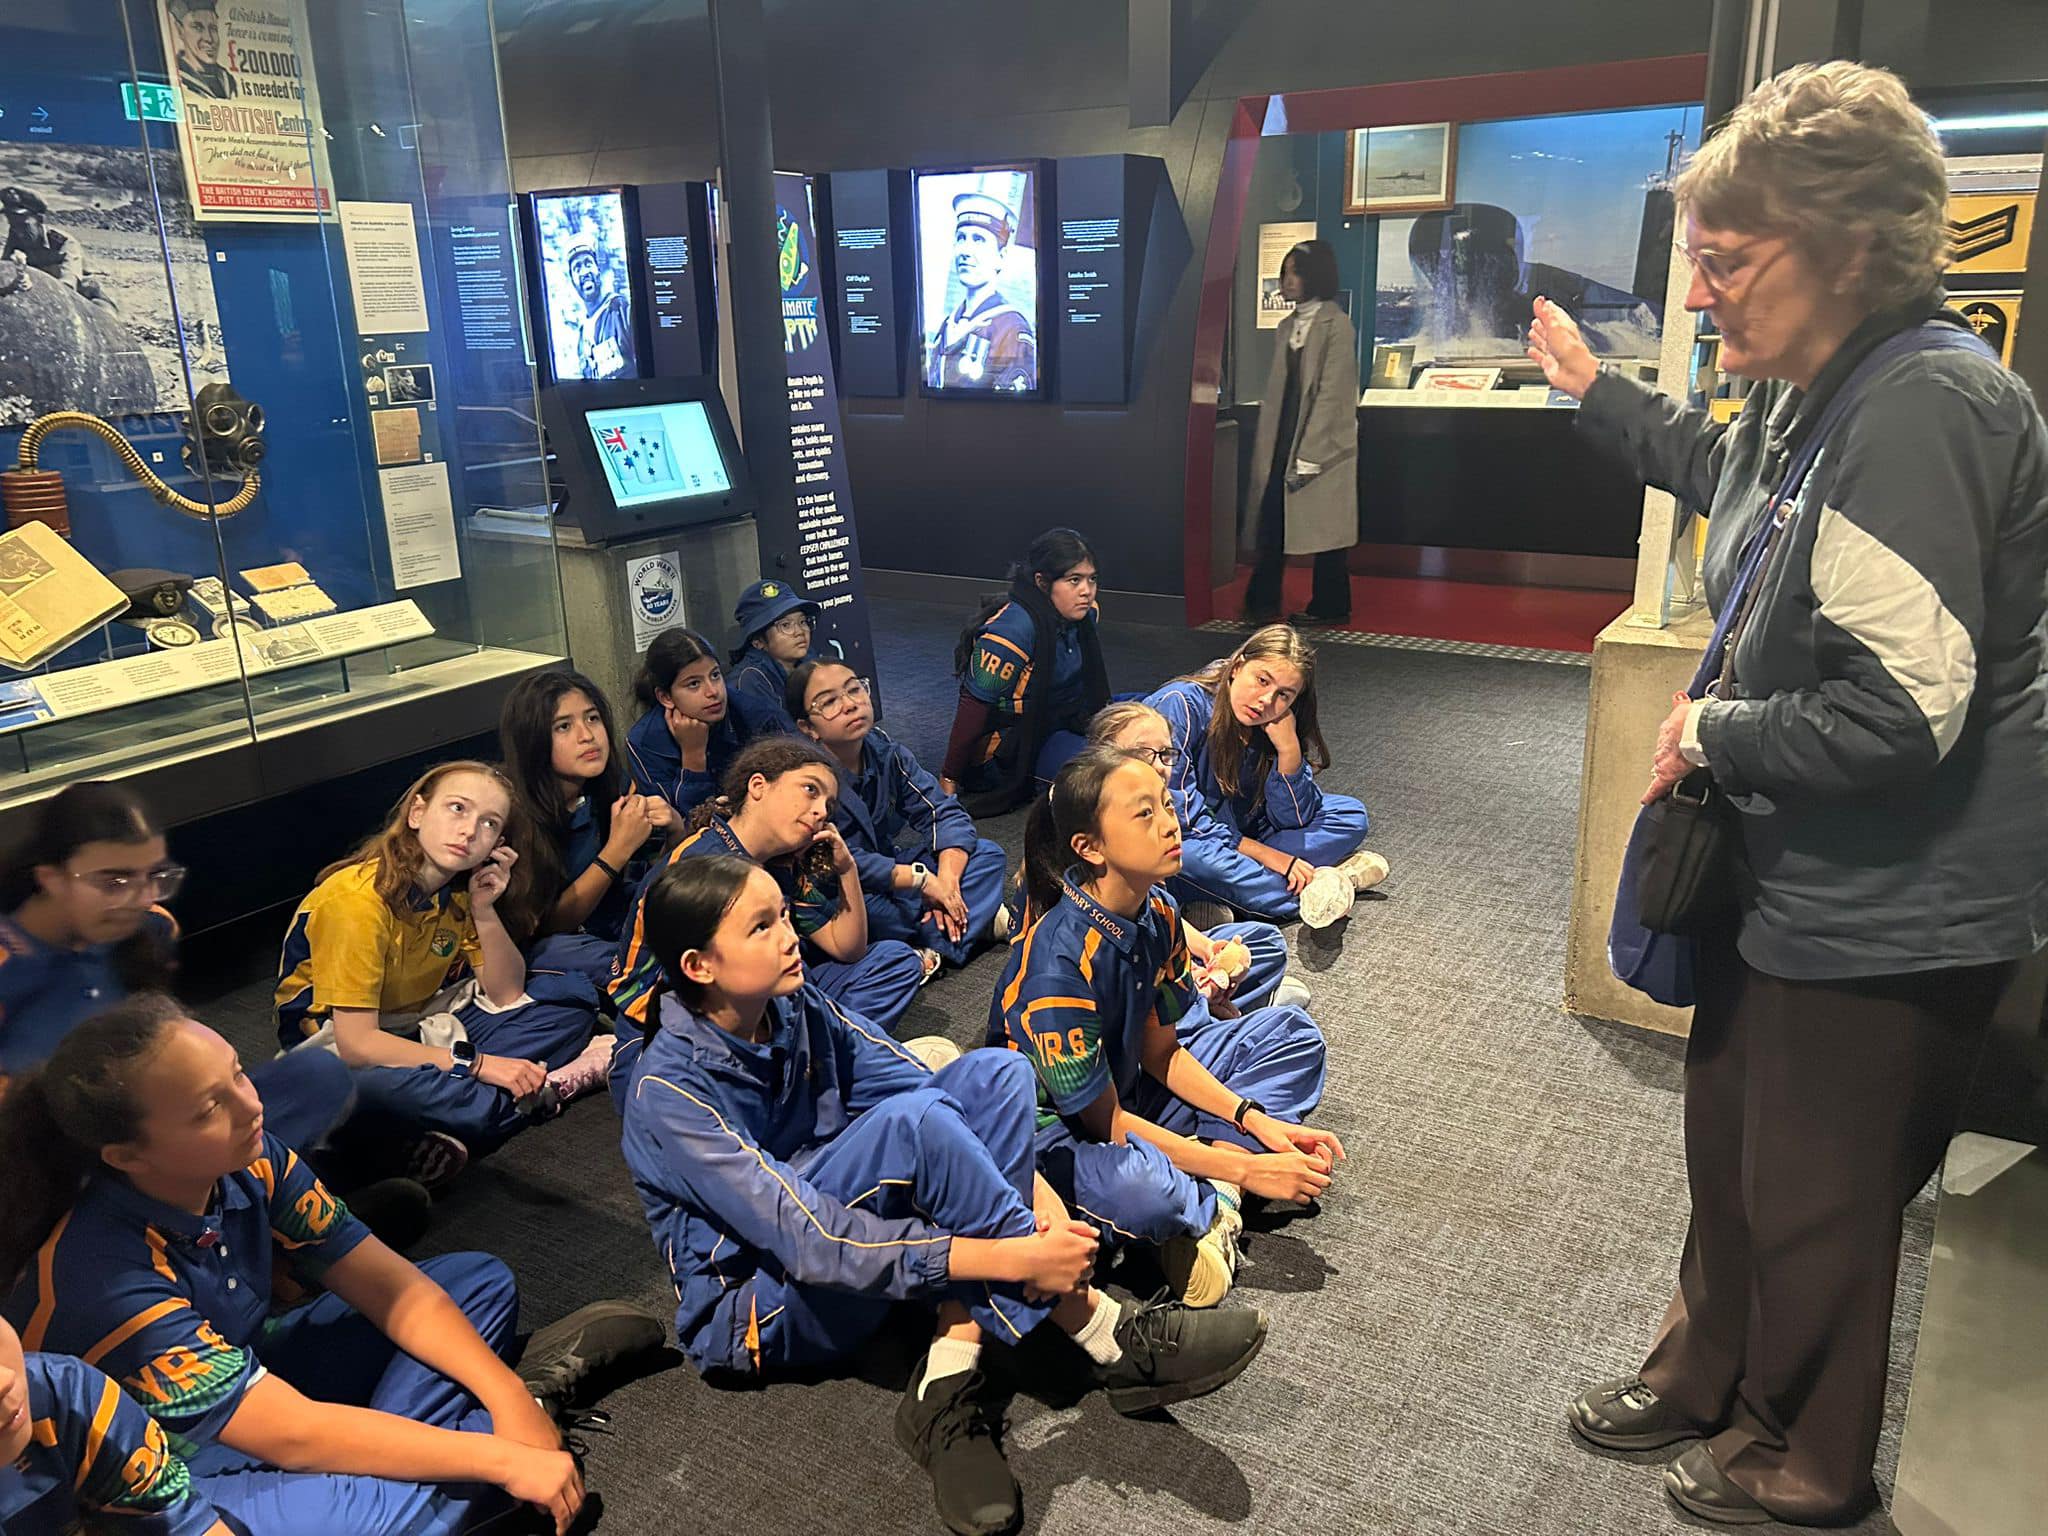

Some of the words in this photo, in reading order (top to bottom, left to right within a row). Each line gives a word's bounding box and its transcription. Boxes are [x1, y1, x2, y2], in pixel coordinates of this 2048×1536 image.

[240, 79, 251, 96] is
[252, 80, 290, 98] needed
[187, 104, 212, 127] The
[210, 105, 276, 136] BRITISH
[782, 300, 814, 317] IMATE
[800, 542, 819, 555] EEPSEA
[634, 560, 655, 587] WORLD
[656, 560, 672, 575] WAR
[980, 648, 1002, 676] YR
[1000, 662, 1015, 681] 6
[1089, 908, 1125, 940] SCHOOL
[1067, 1026, 1087, 1059] 6
[122, 1346, 214, 1405] YR
